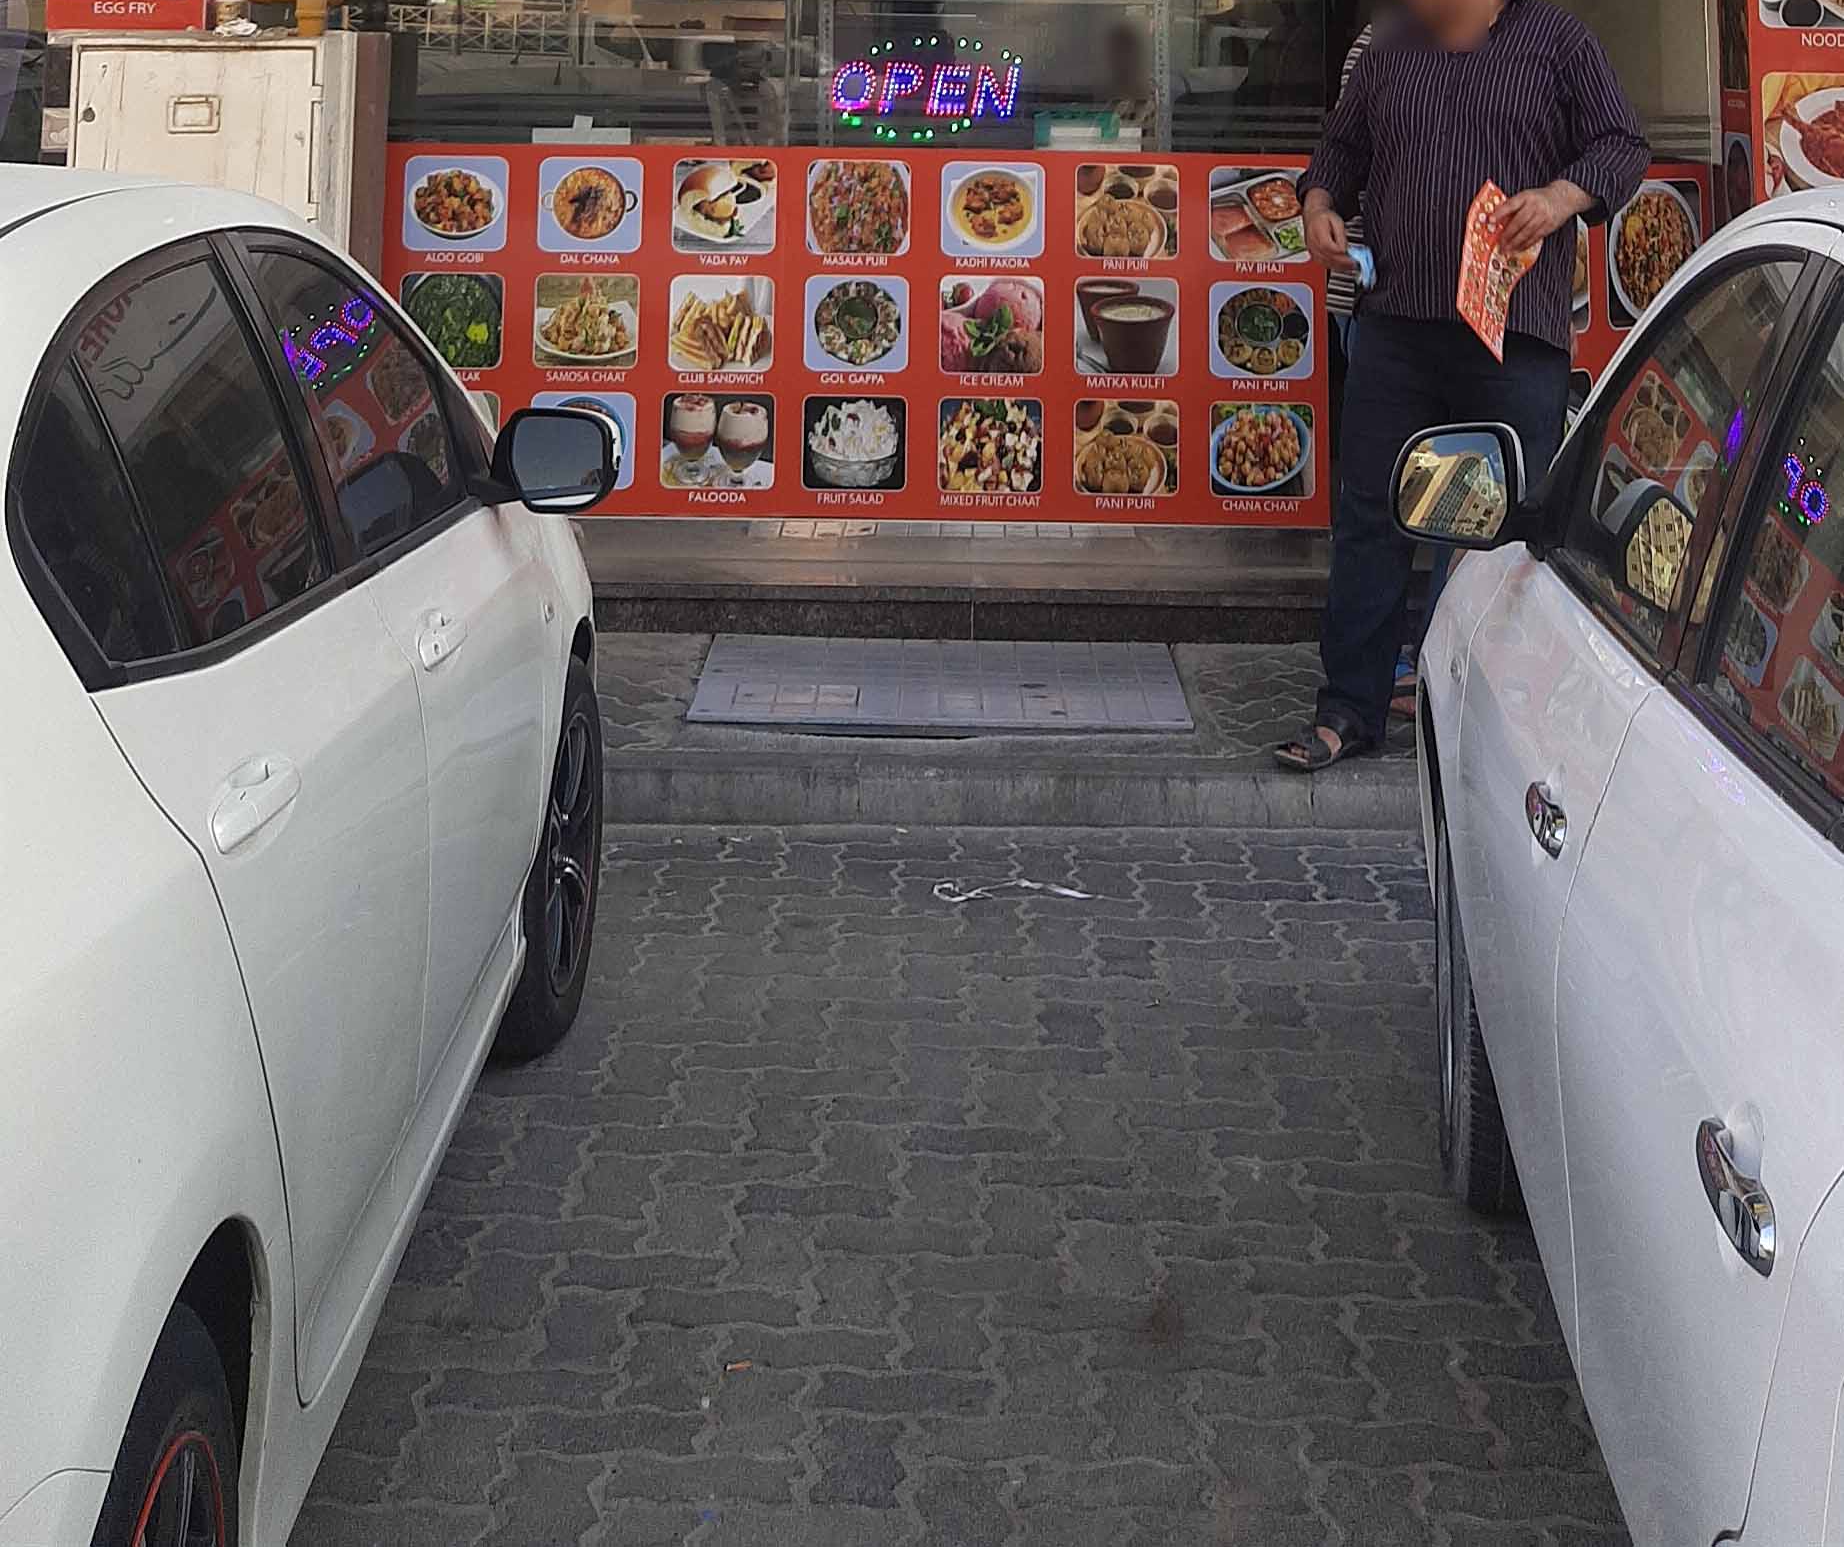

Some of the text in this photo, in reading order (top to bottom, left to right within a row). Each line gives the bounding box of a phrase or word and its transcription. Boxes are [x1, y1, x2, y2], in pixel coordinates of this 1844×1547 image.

[93, 0, 156, 17] EGG FRY
[832, 59, 1021, 117] OPEN
[425, 253, 484, 263] ALOO GOBI
[560, 253, 620, 265] DAL CHANA
[729, 255, 748, 266] PAV
[822, 256, 888, 267] MASALA PURI
[955, 258, 1030, 269] KADHI PAKORA
[1103, 259, 1149, 271] PANI PURI
[1235, 262, 1284, 274] PAV BHAJI
[546, 371, 625, 383] SAMOSA CHAAT
[678, 373, 763, 385] CLUB SANDWICH
[819, 373, 885, 386] GOL GAPPA
[959, 375, 1024, 387] ICE CREAM
[1086, 376, 1165, 389] MATKA KULFI
[1232, 379, 1288, 391] PANI PURI
[688, 491, 746, 504] FALOODA
[817, 492, 884, 506] FRUIT SALAD
[940, 494, 1041, 508] MIXED FRUIT CHAAT
[1095, 497, 1155, 510] PANI PURI
[1222, 499, 1300, 512] CHANA CHAAT
